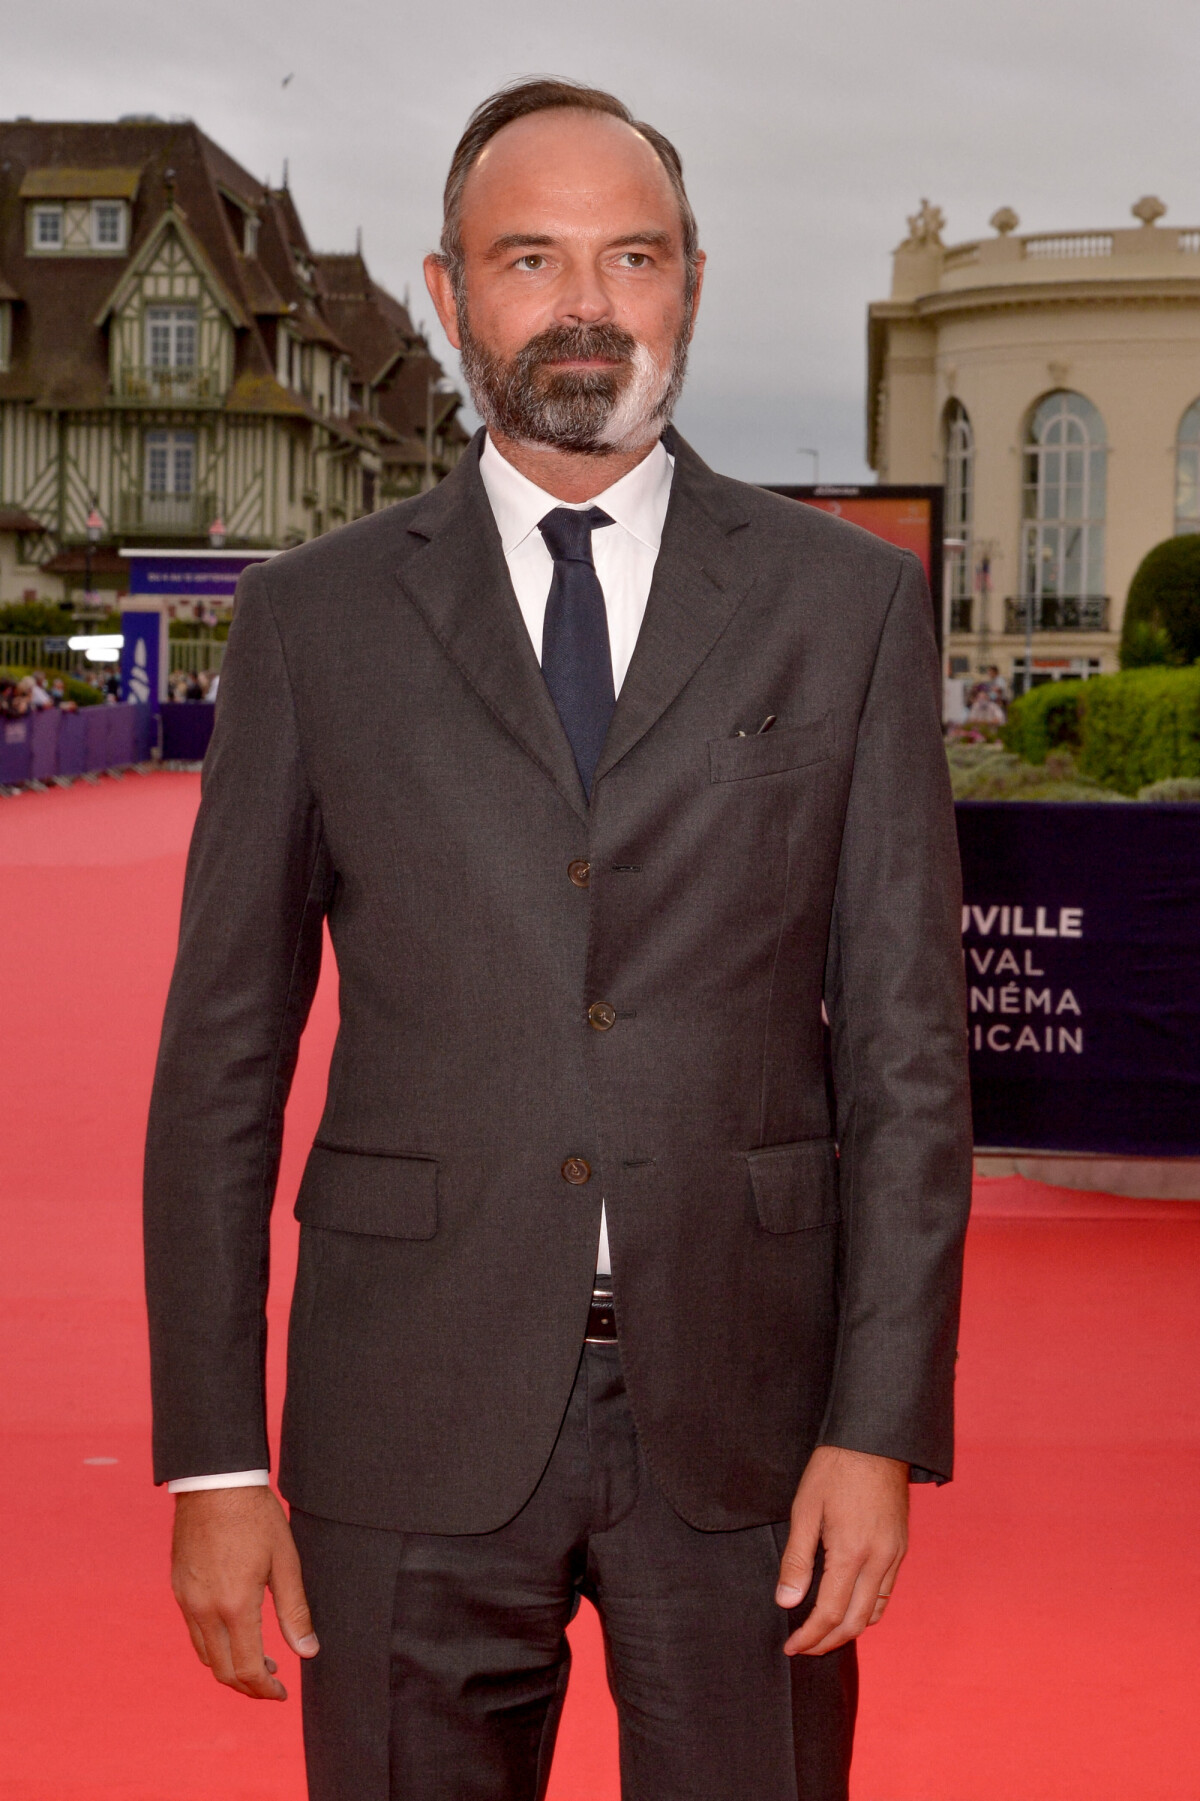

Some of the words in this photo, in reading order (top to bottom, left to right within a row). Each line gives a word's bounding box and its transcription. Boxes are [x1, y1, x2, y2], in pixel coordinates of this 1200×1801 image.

[963, 947, 1044, 976] VAL
[970, 981, 1081, 1015] NÉMA
[972, 1023, 1083, 1054] ICAIN
